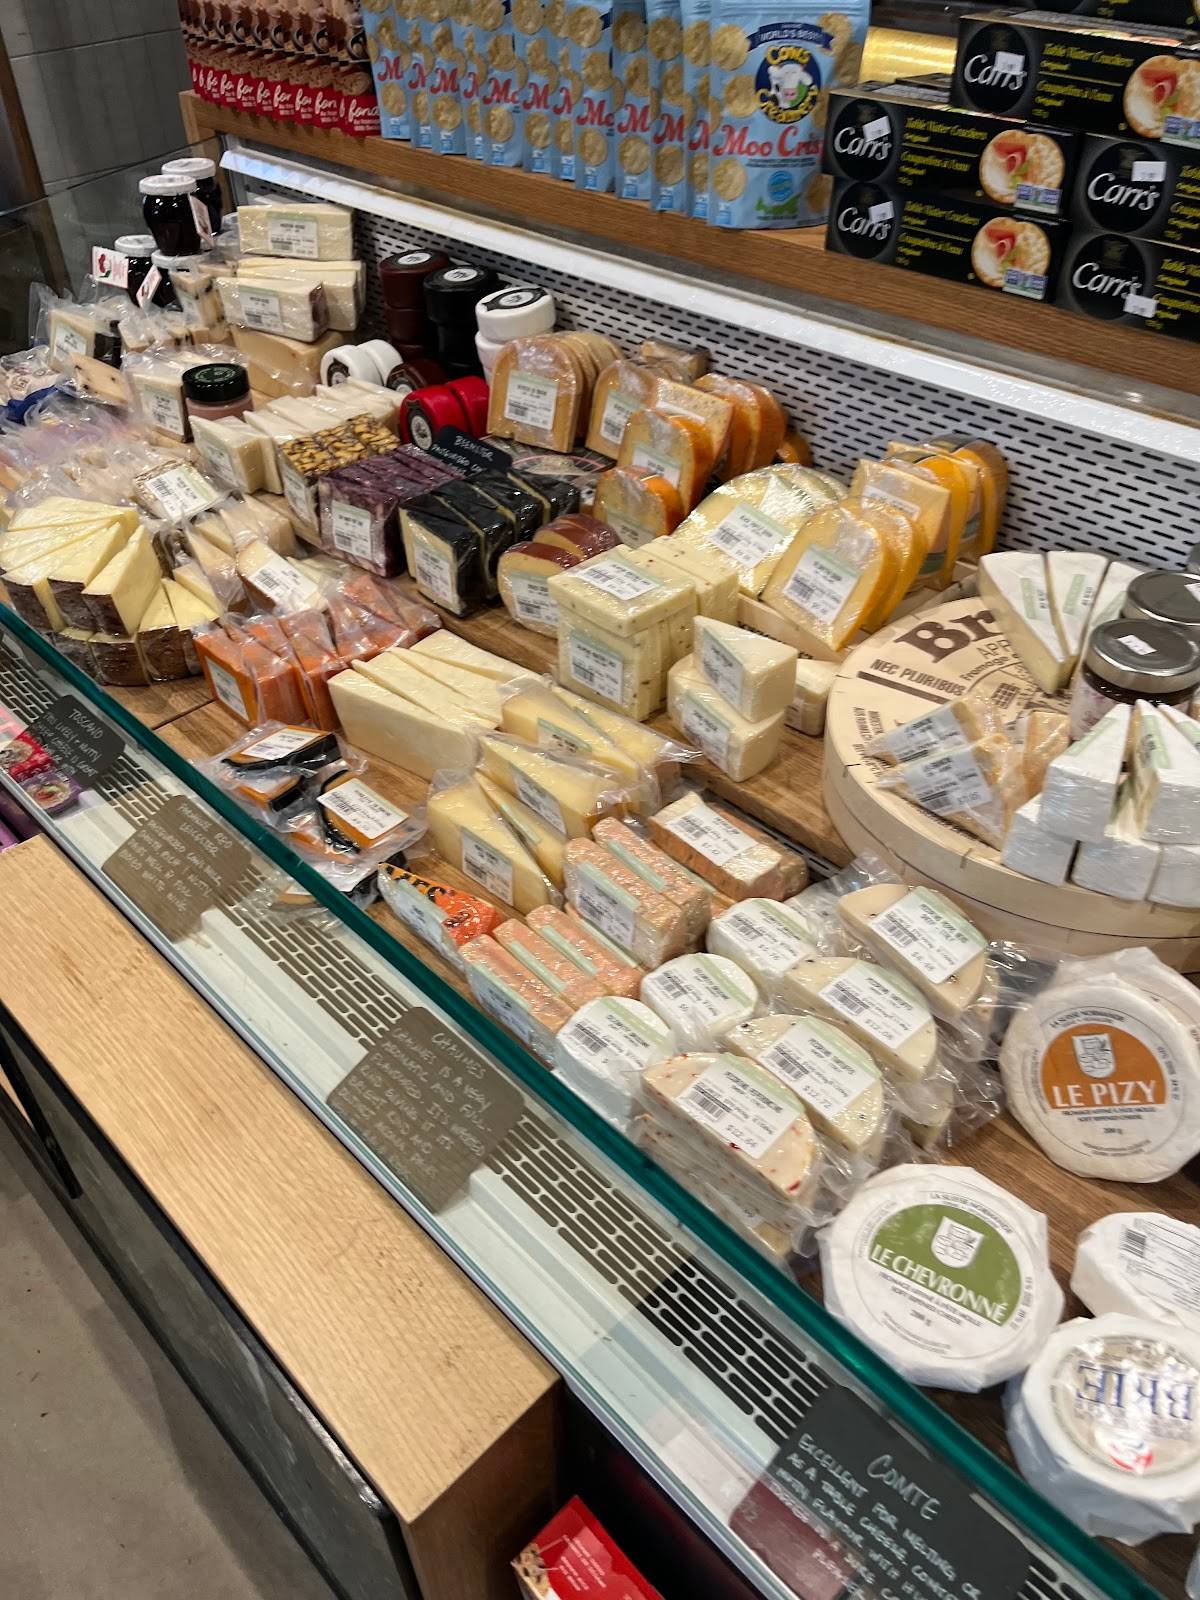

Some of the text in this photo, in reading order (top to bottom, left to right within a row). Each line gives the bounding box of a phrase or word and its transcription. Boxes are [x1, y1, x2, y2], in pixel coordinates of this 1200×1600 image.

[711, 124, 774, 157] Moo
[1087, 172, 1160, 211] Carr's
[870, 658, 967, 697] NEC PLURIBUS
[67, 706, 105, 742] TOSCANO
[212, 830, 234, 851] RED
[1052, 1080, 1156, 1108] LE PIZY
[869, 1243, 894, 1266] LE
[887, 1253, 1009, 1323] CHEVRONNÉ
[784, 1449, 808, 1472] AS
[814, 1477, 860, 1519] TABLE
[794, 1431, 871, 1501] EXCELLENT
[869, 1500, 904, 1532] FOR
[863, 1448, 947, 1526] COMTE
[808, 1496, 868, 1550] FLAVOUR
[864, 1546, 902, 1582] WITH
